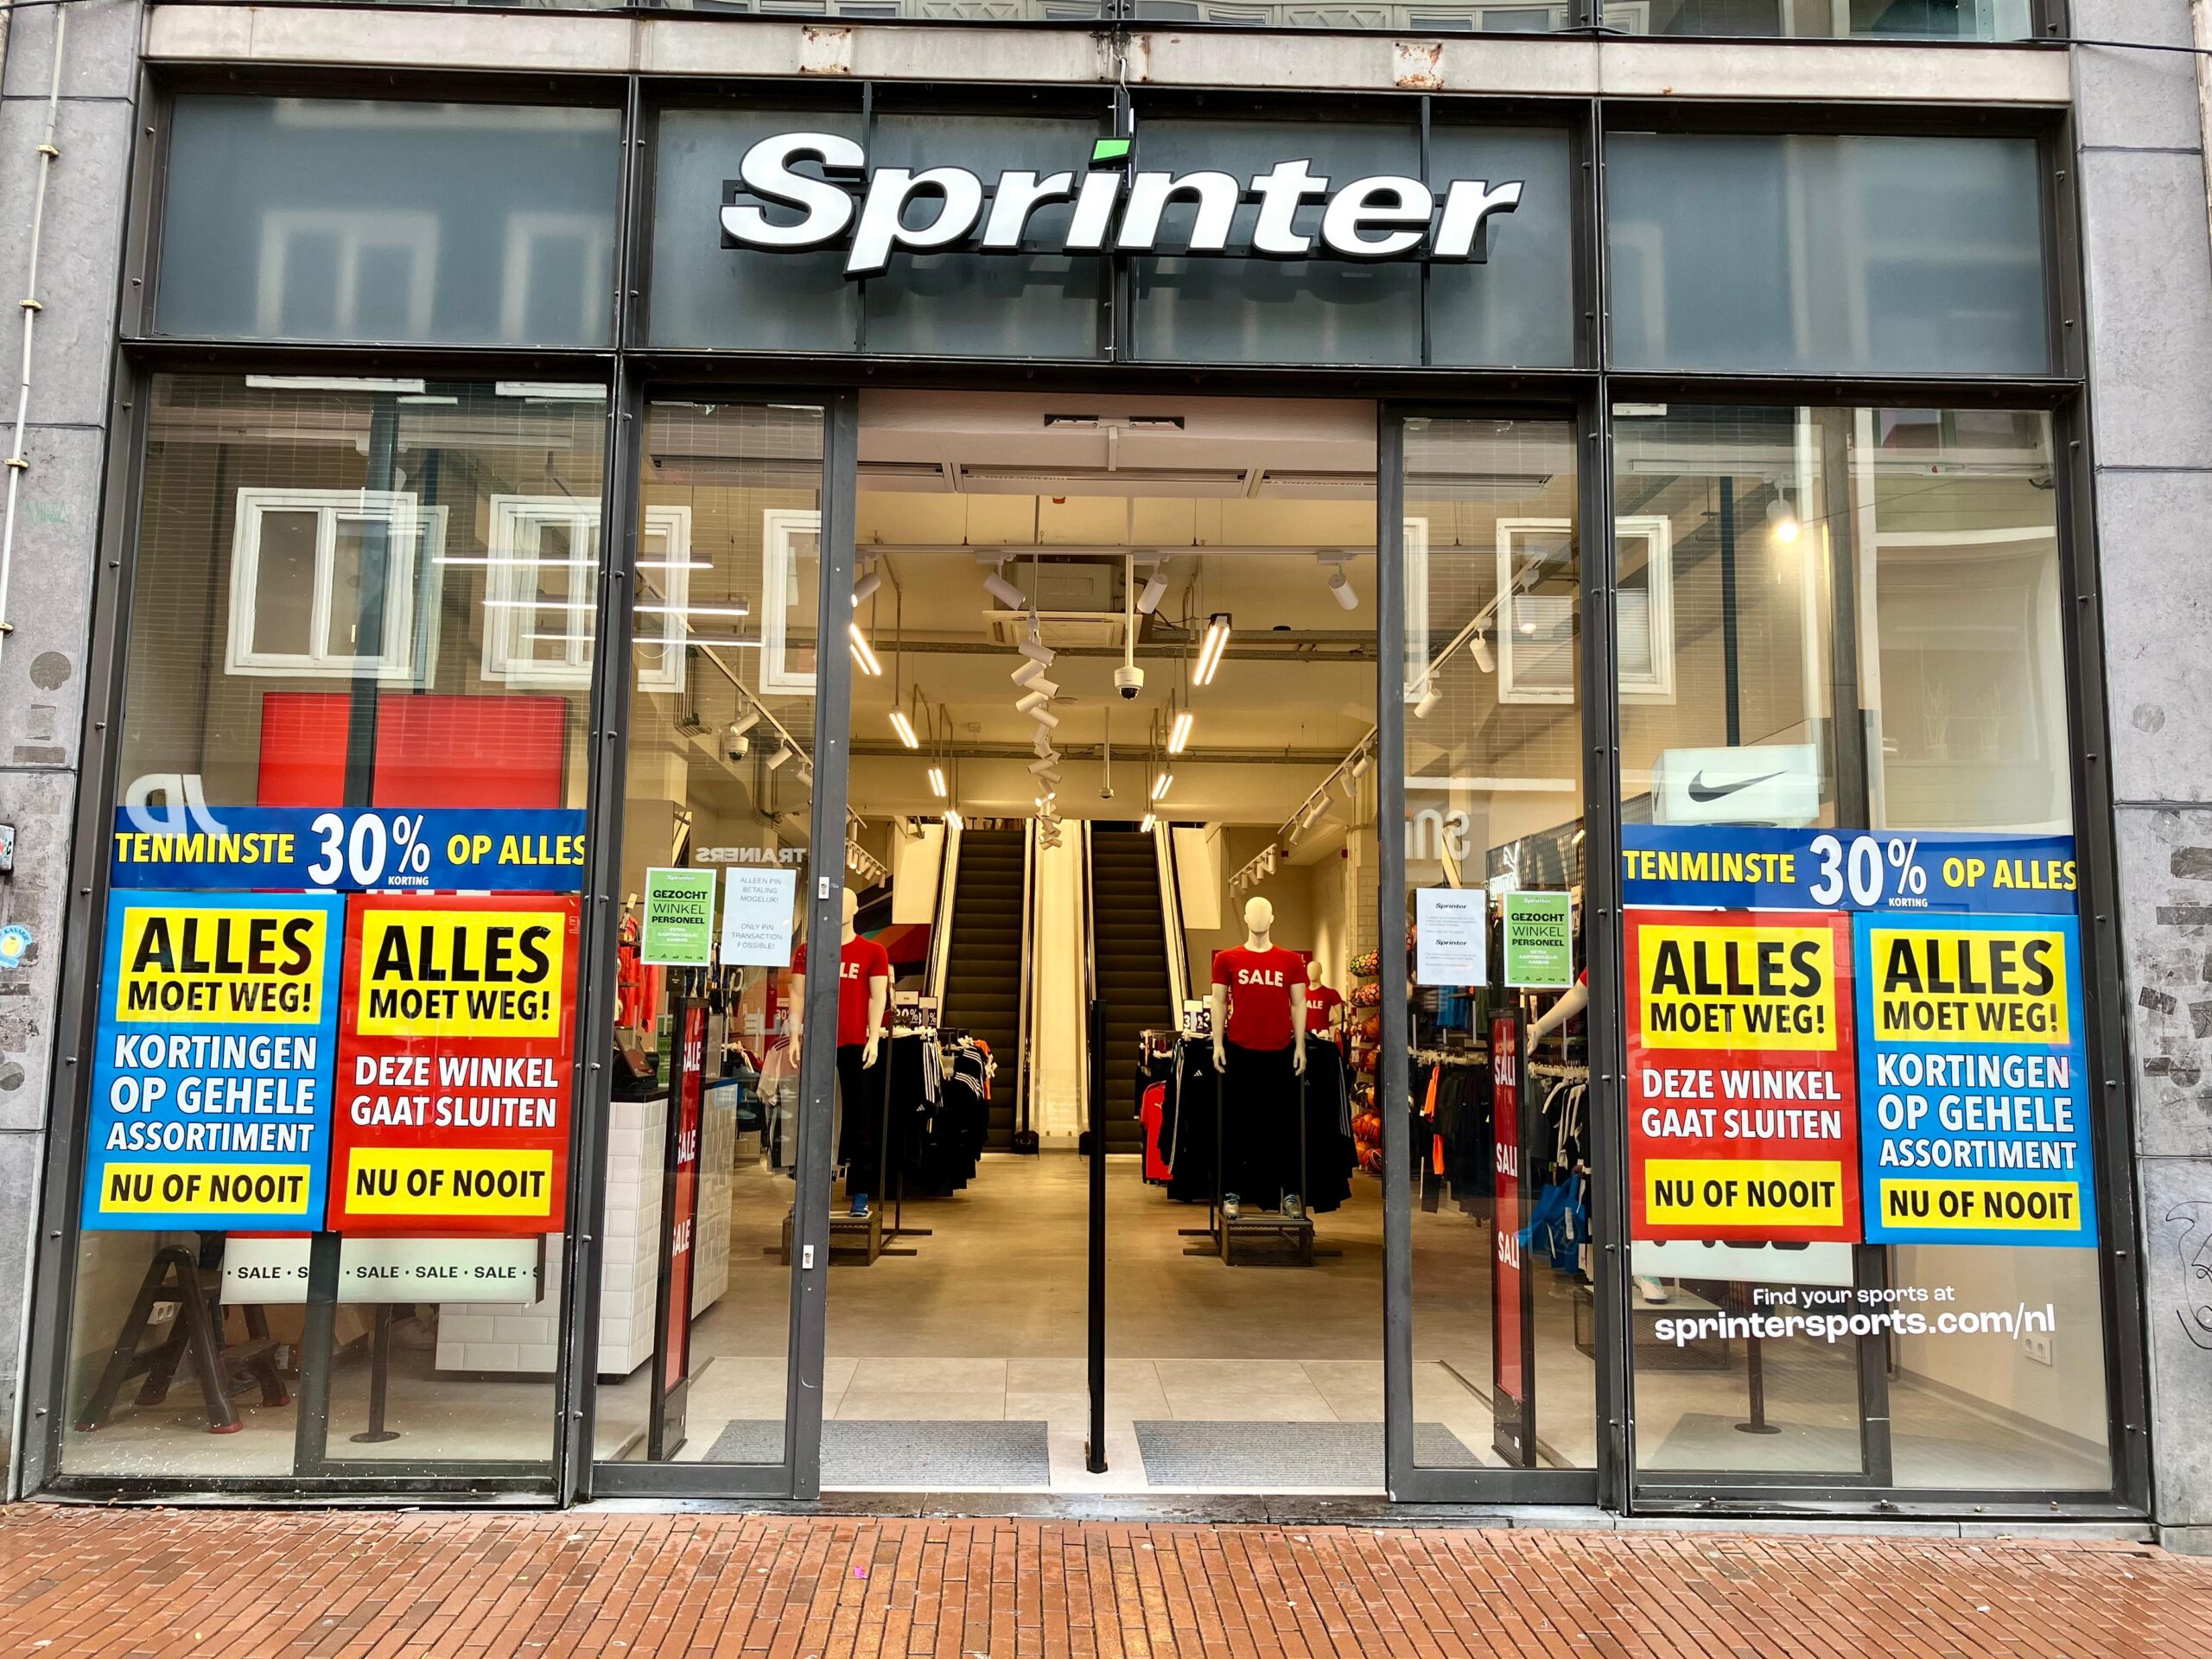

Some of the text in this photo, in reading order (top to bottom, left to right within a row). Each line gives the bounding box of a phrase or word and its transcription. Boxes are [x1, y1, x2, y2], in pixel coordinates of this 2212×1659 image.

[719, 131, 1525, 276] Sprinter
[115, 812, 586, 886] TENMINSTE 30% OP ALLES
[388, 875, 429, 886] KORTING
[1623, 834, 2077, 906] TENMINSTE 30% OP ALLES
[652, 889, 708, 900] GEZOCHT
[653, 903, 705, 915] WINKEL
[1888, 898, 1928, 907] KORTING
[652, 916, 705, 925] PERSONEEL
[1511, 912, 1565, 922] GEZOCHT
[1512, 925, 1564, 937] WINKEL
[130, 916, 315, 976] ALLES
[372, 925, 551, 983] ALLES
[1512, 938, 1565, 947] PERSONEEL
[839, 962, 860, 979] LE
[1238, 969, 1283, 988] SALE
[1650, 940, 1821, 998] ALLES
[1883, 938, 2054, 996] ALLES
[127, 981, 312, 1013] MOET WEG!
[369, 988, 550, 1020] MOET WEG!
[1306, 1001, 1323, 1009] ALE
[1650, 1002, 1824, 1034] MOET WEG!
[1883, 1001, 2057, 1033] MOET WEG!
[114, 1034, 317, 1070] KORTINGEN
[355, 1056, 559, 1088] DEZE WINKEL
[1642, 1069, 1841, 1100] DEZE WINKEL
[1876, 1052, 2070, 1089] KORTINGEN
[110, 1075, 316, 1115] OP GEHELE
[351, 1096, 556, 1128] GAAT SLUITEN
[1642, 1108, 1842, 1140] GAAT SLUITEN
[1877, 1093, 2075, 1133] OP GEHELE
[105, 1122, 315, 1152] ASSORTIMENT
[1879, 1138, 2077, 1170] ASSORTIMENT
[110, 1174, 302, 1203] NU OF NOOIT
[356, 1168, 545, 1198] NU OF NOOIT
[1655, 1180, 1835, 1208] NU OF NOOIT
[1890, 1190, 2073, 1219] NU OF NOOIT
[238, 1266, 517, 1279] SALE SALE SALE SALE
[1753, 1286, 1955, 1313] Find your sports at
[1655, 1302, 2056, 1347] sprintersports.com/nl
